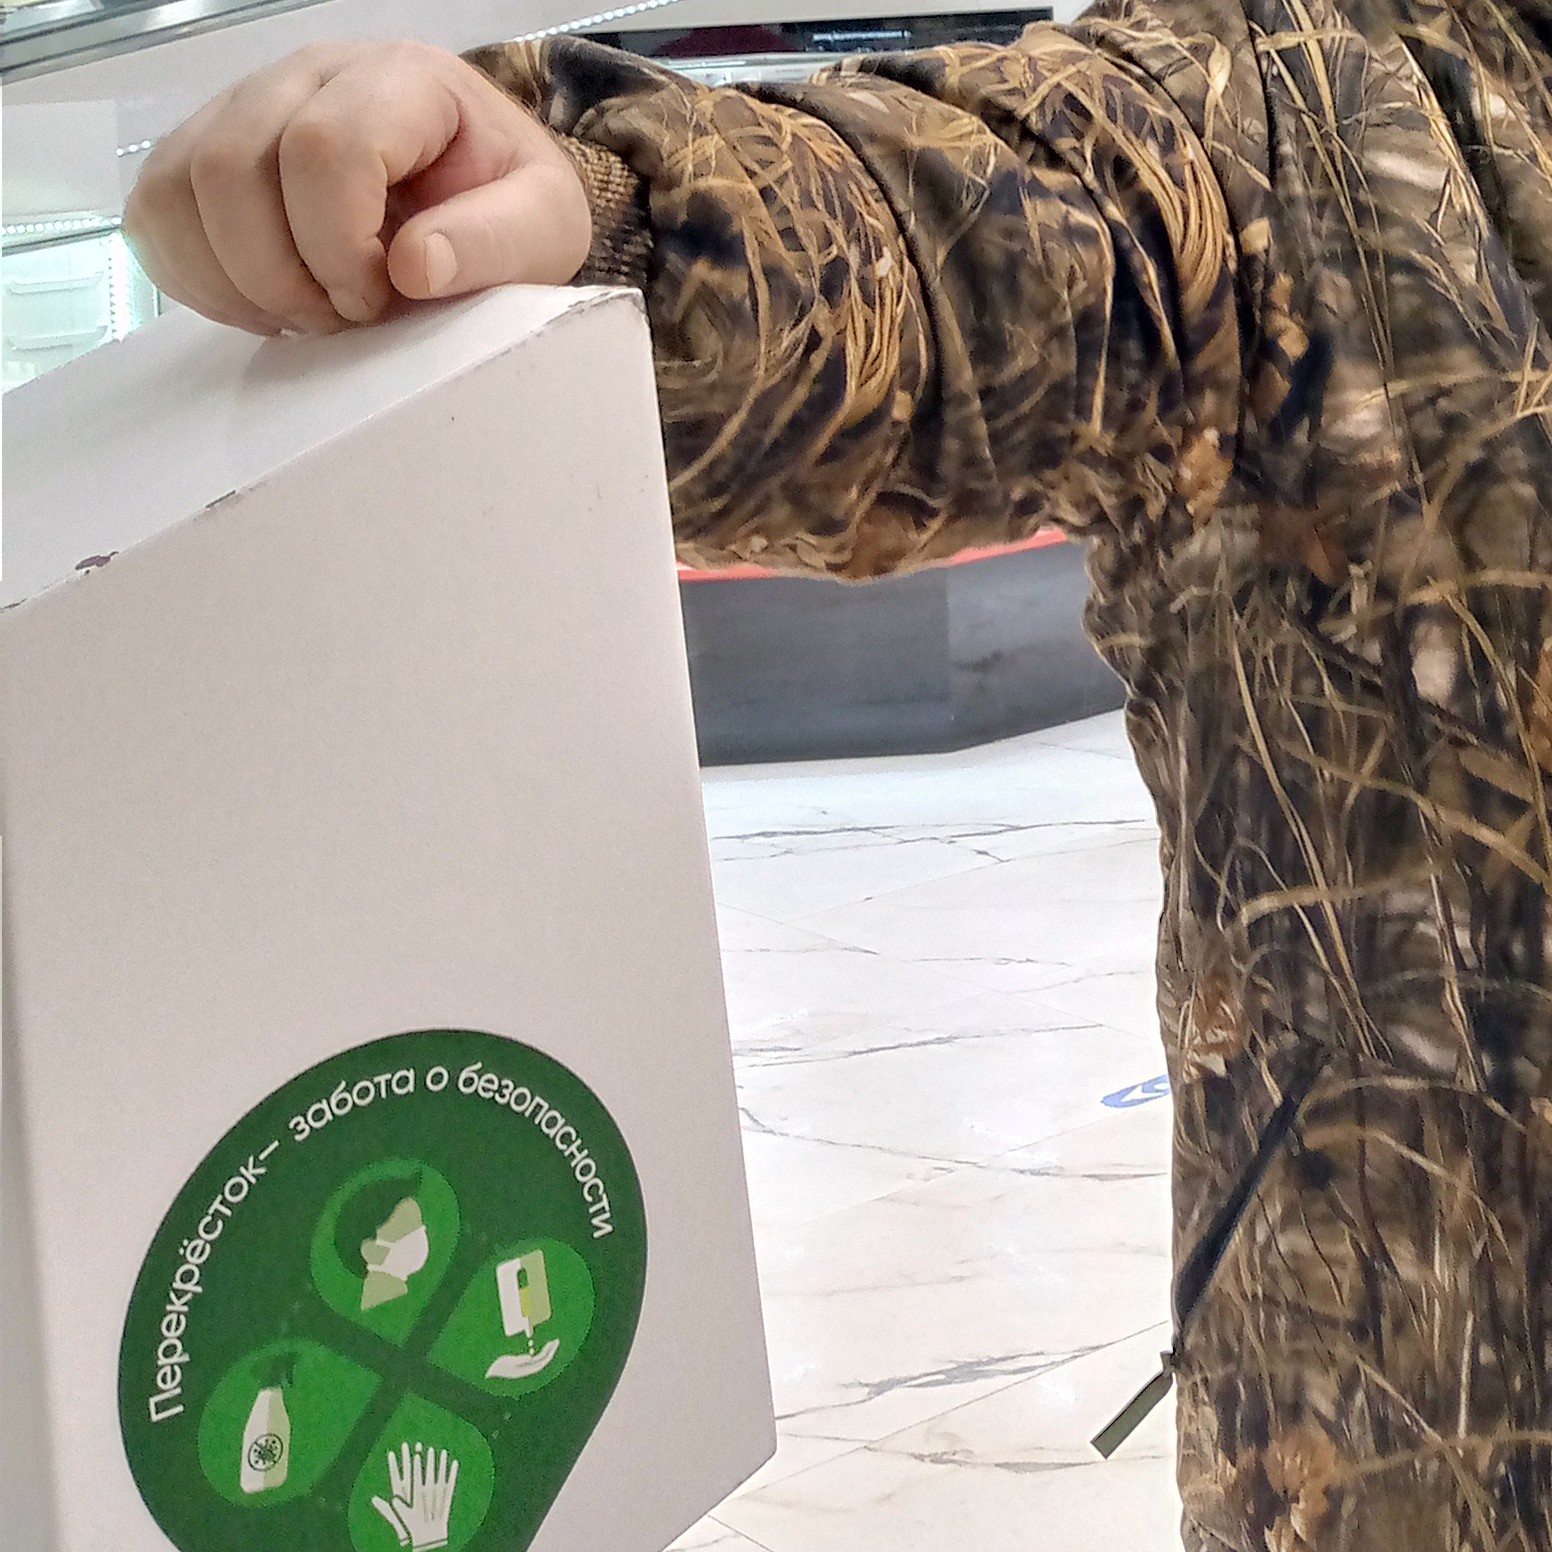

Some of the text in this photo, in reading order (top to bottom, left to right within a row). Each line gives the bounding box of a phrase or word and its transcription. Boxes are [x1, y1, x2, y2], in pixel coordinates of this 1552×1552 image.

[288, 1067, 415, 1142] забота
[426, 1065, 449, 1092] о
[457, 1061, 614, 1239] безопасности
